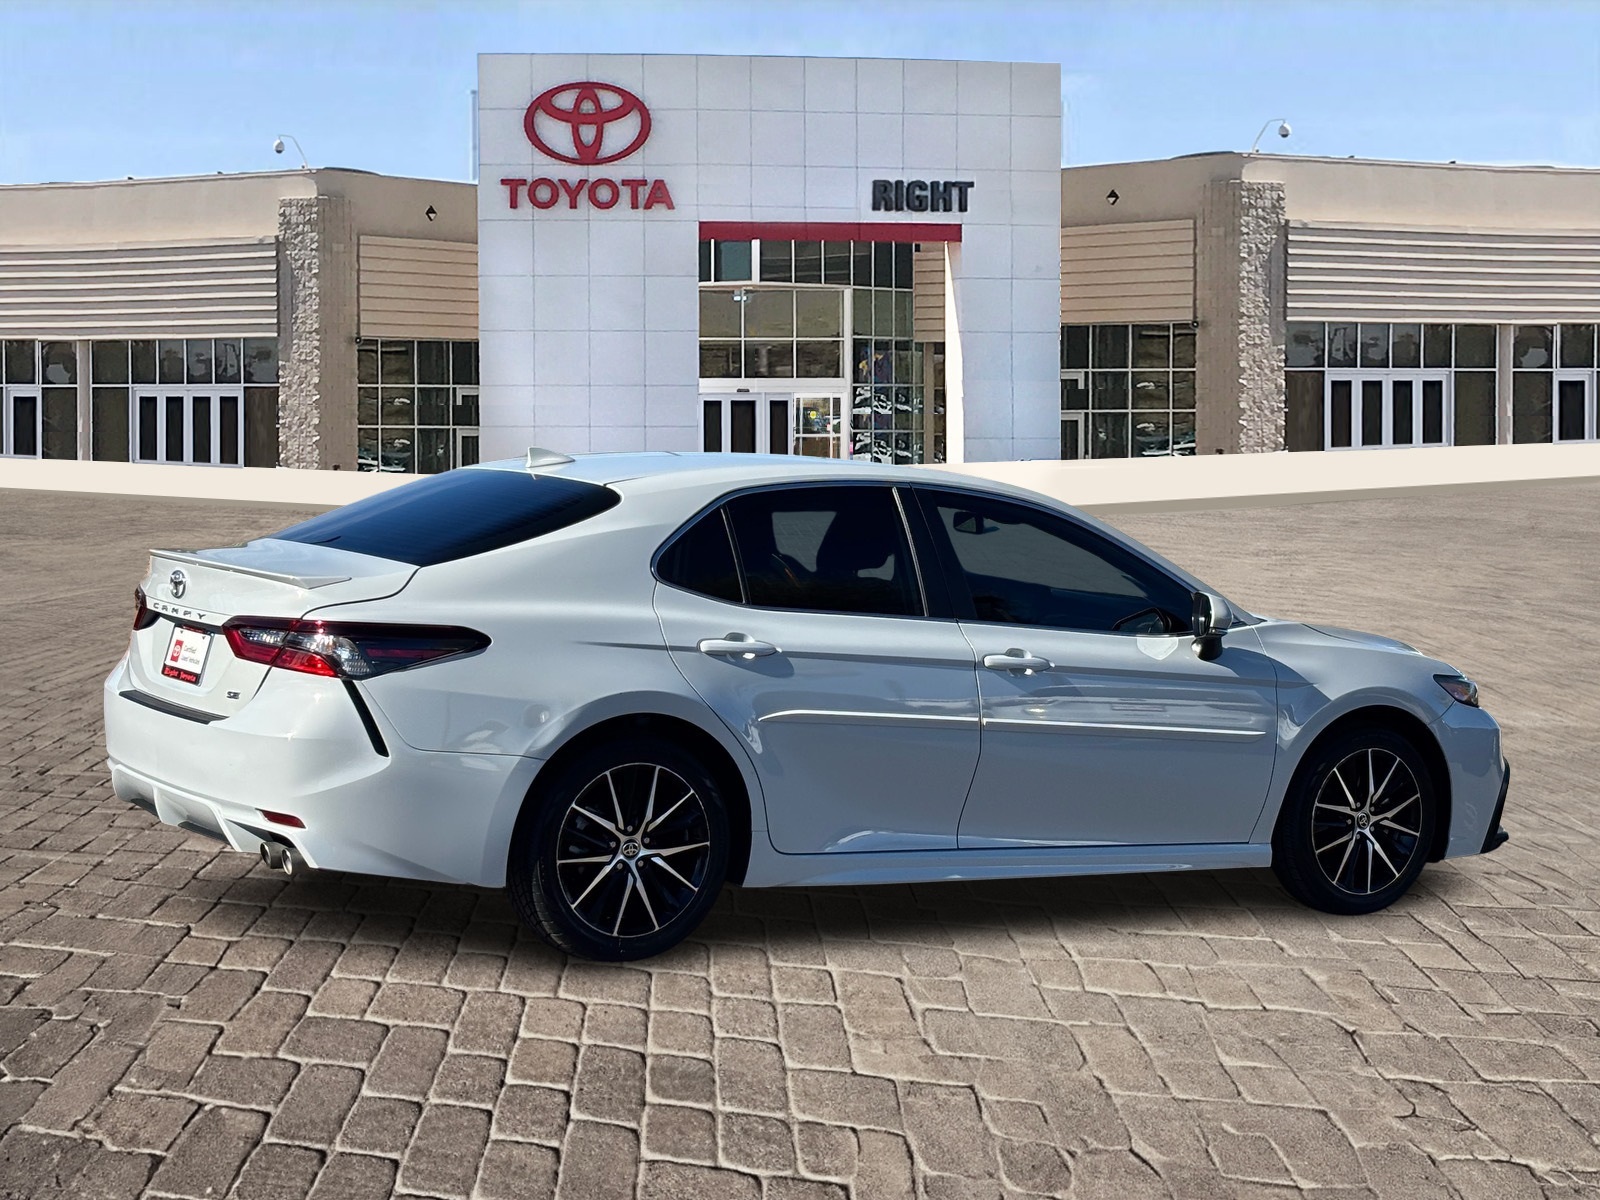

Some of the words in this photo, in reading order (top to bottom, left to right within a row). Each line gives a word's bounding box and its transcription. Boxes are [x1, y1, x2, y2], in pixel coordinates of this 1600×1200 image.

[501, 178, 675, 210] TOYOTA
[872, 180, 974, 212] RIGHT
[153, 603, 206, 619] CAMRY
[226, 691, 240, 699] SE
